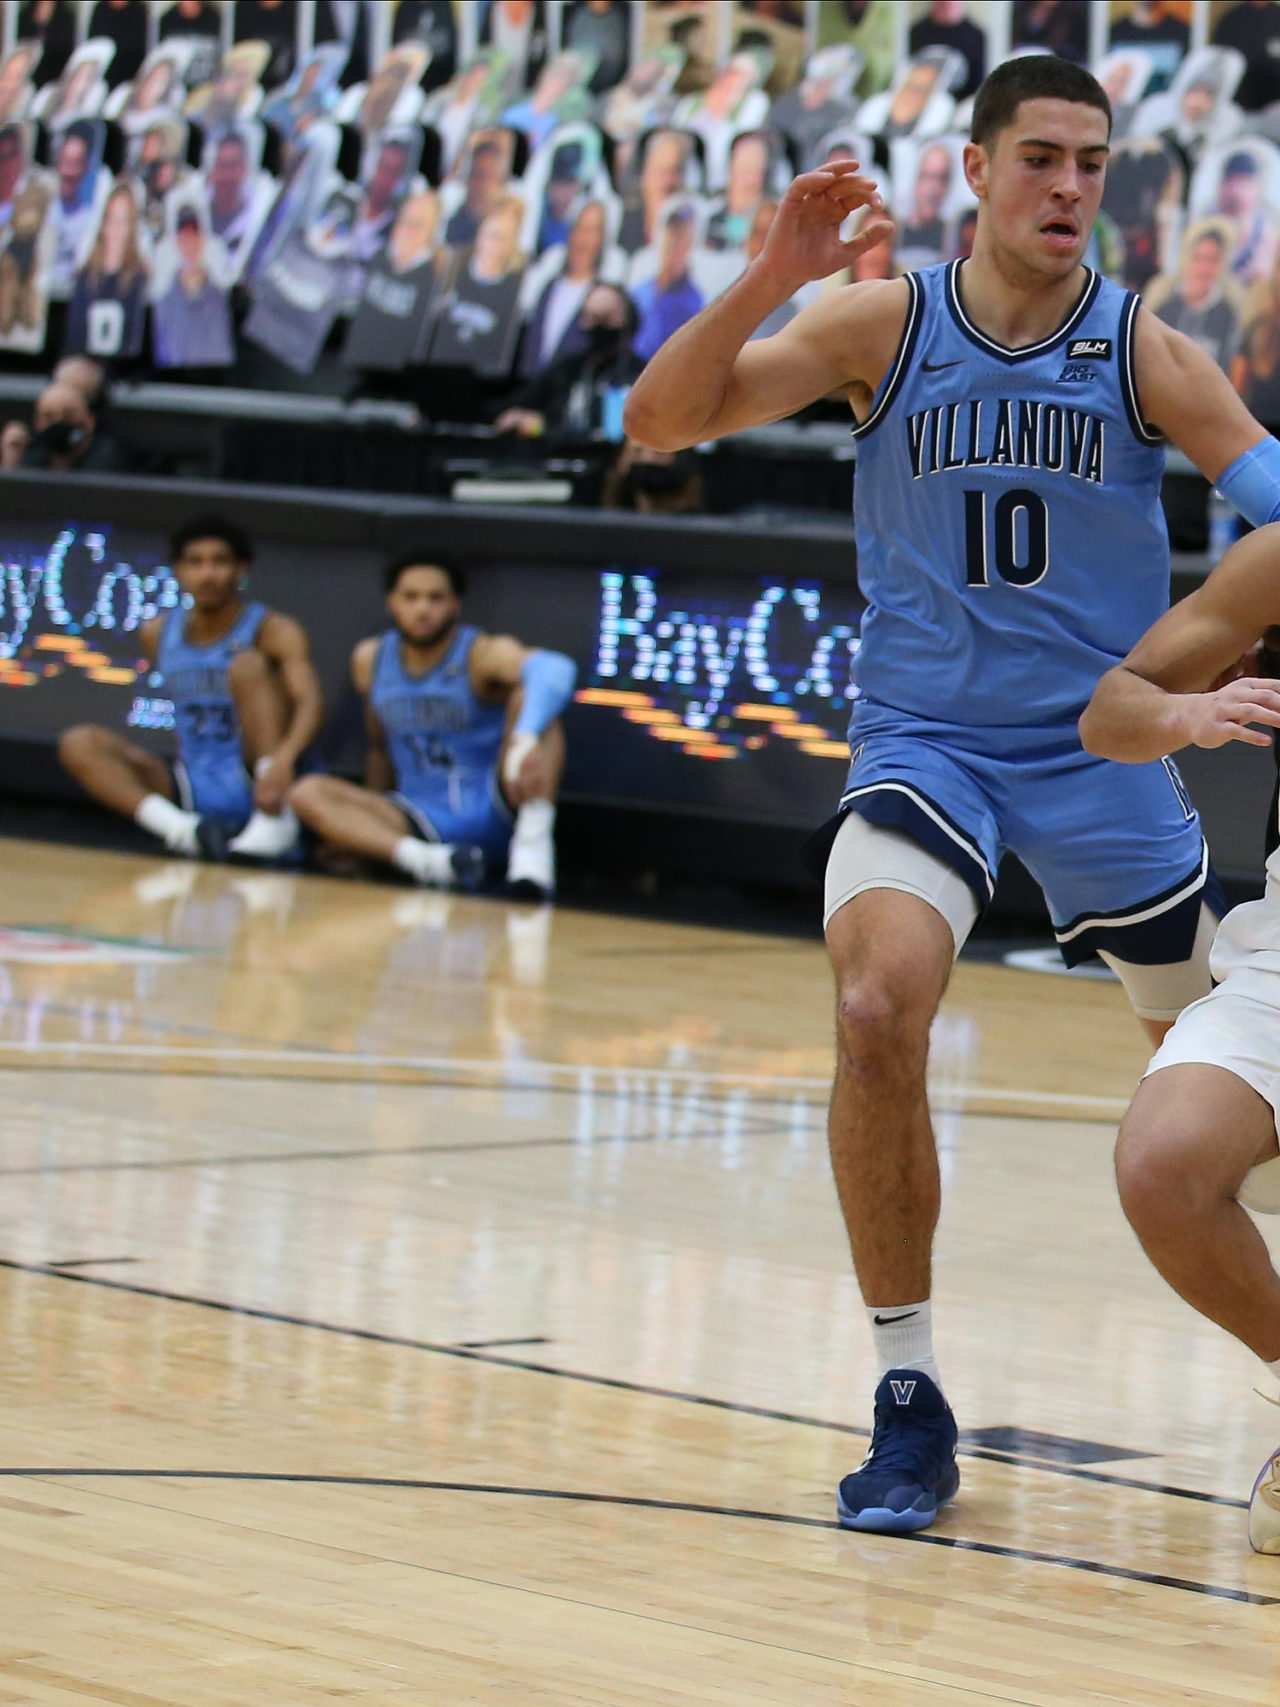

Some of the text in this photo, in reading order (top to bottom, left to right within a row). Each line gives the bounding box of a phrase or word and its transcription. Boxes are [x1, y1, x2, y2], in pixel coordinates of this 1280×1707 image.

[1071, 341, 1108, 352] BLM
[1058, 372, 1098, 382] EAST
[1063, 364, 1090, 373] BIG
[907, 398, 1104, 486] VILLANOVA
[964, 489, 1049, 588] 10
[889, 1380, 917, 1405] V
